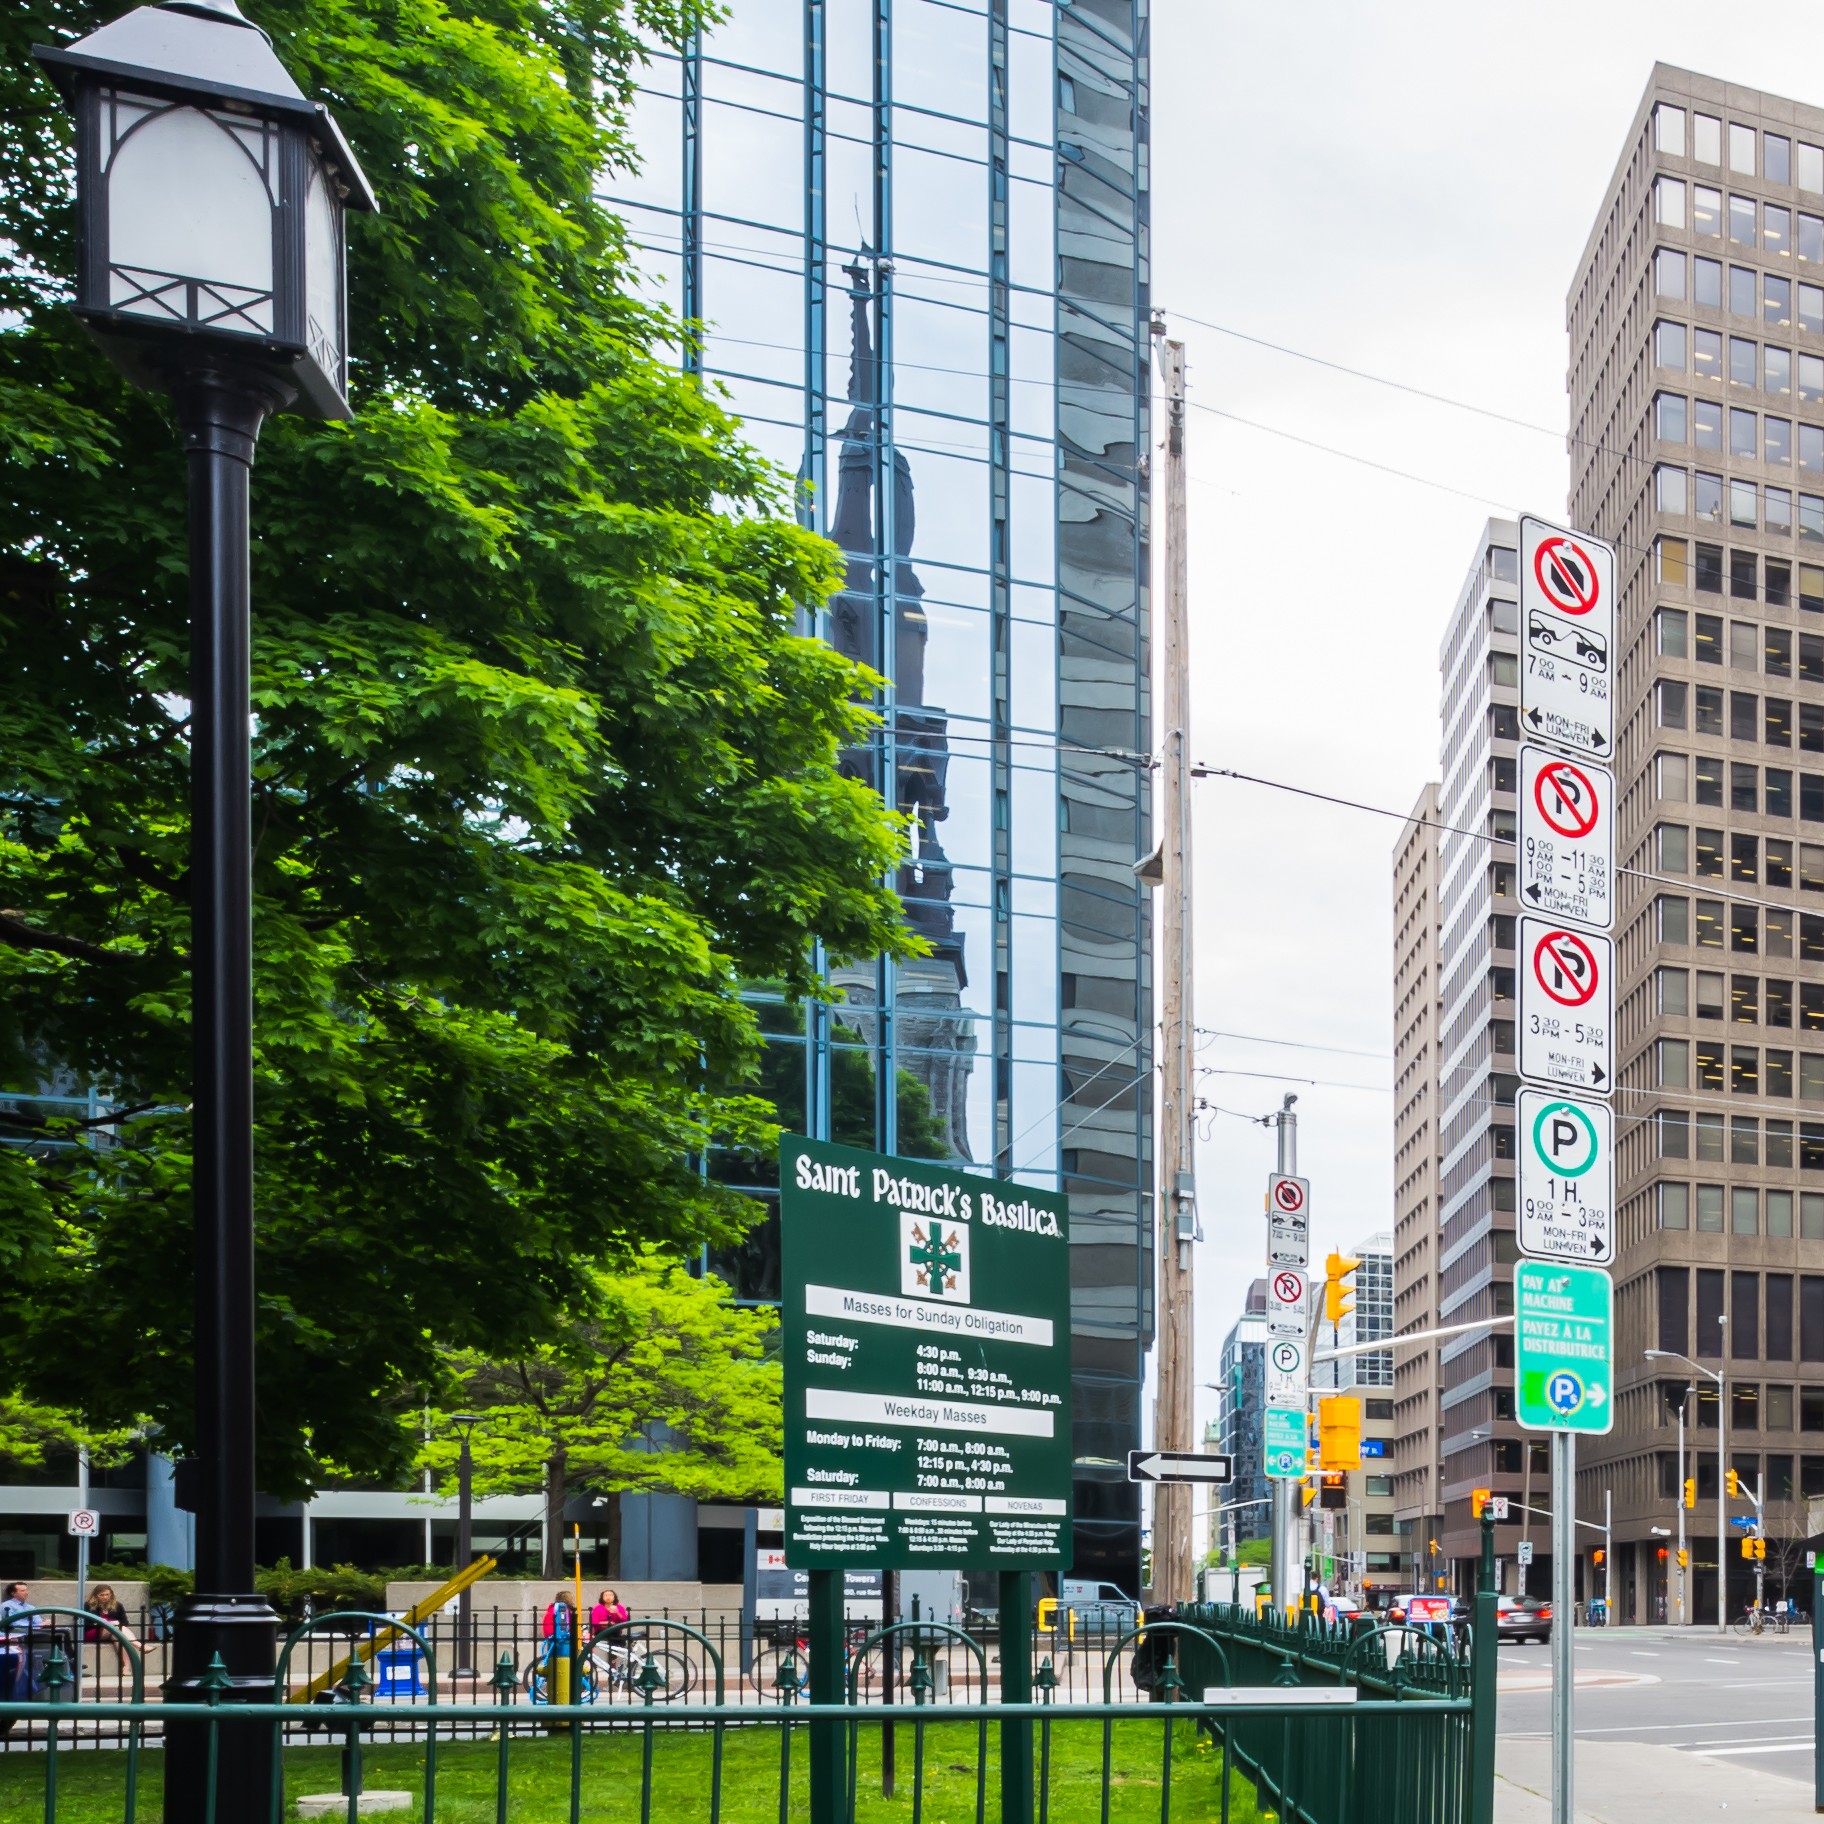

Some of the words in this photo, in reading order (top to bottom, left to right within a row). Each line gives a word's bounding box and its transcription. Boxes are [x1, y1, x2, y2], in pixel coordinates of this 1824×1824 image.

[1528, 654, 1536, 673] 7
[1538, 670, 1554, 682] AM
[1579, 673, 1587, 693] 9
[1590, 689, 1606, 699] AM
[1547, 712, 1589, 734] MON-FRI
[1547, 723, 1589, 745] LUNVEN
[1527, 837, 1534, 857] 9
[1537, 852, 1553, 863] AM
[1590, 855, 1604, 865] 30
[1536, 873, 1552, 884] PM
[1588, 866, 1605, 878] AM
[1579, 874, 1585, 893] 5
[1590, 877, 1604, 888] 30
[1545, 887, 1588, 907] MON-FRI
[1589, 888, 1605, 899] PM
[1530, 1015, 1539, 1034] 3
[1543, 1017, 1560, 1028] 30
[1587, 1026, 1603, 1037] 30
[1543, 1029, 1560, 1039] PM
[1575, 1023, 1584, 1043] 5
[1587, 1038, 1603, 1048] PM
[1548, 1052, 1584, 1068] MON-FRI
[1553, 1119, 1578, 1156] P
[796, 1154, 860, 1199] Saint
[872, 1168, 972, 1220] Patrick's
[980, 1192, 1059, 1237] Basilica
[1548, 1178, 1555, 1199] 1
[1526, 1199, 1534, 1218] 9
[1537, 1212, 1553, 1222] AM
[1579, 1207, 1586, 1227] 3
[1589, 1209, 1605, 1219] 30
[1543, 1226, 1586, 1241] MON-FRI
[1589, 1220, 1605, 1230] PM
[1543, 1239, 1586, 1254] LUNVEN
[1522, 1275, 1544, 1290] PAY
[1548, 1278, 1562, 1292] AT
[1522, 1292, 1574, 1312] MACHINE
[843, 1297, 891, 1319] Masses
[896, 1304, 912, 1319] for
[916, 1307, 961, 1329] Sunday
[965, 1315, 1023, 1334] Obligation
[807, 1330, 859, 1350] Saturday:
[1522, 1320, 1559, 1337] PAYEZ
[1576, 1326, 1592, 1341] LA
[917, 1344, 938, 1361] 4:30
[940, 1349, 961, 1363] p.m.
[1523, 1337, 1606, 1360] DISTRIBUTRICE
[807, 1349, 852, 1369] Sunday:
[917, 1362, 939, 1376] 8:00
[967, 1366, 988, 1381] 9:30
[917, 1378, 944, 1392] 11:00
[971, 1384, 996, 1398] 12:15
[1021, 1389, 1041, 1402] 9:00
[1042, 1392, 1062, 1405] p.m.
[884, 1401, 939, 1423] Weekday
[943, 1408, 987, 1424] Masses
[807, 1430, 850, 1449] Monday
[851, 1435, 863, 1447] to
[865, 1435, 902, 1452] Friday:
[917, 1438, 939, 1452] 7:00
[965, 1441, 985, 1456] 8:00
[917, 1456, 944, 1470] 12:15
[993, 1462, 1013, 1475] p.m.
[807, 1468, 859, 1486] Saturday:
[917, 1474, 939, 1488] 7:00
[965, 1476, 985, 1490] 8:00
[811, 1492, 835, 1503] FIRST
[838, 1493, 869, 1505] FRIDAY
[910, 1496, 967, 1508] CONFESSIONS
[1007, 1500, 1043, 1511] NOVENAS
[845, 1574, 876, 1583] Towers
